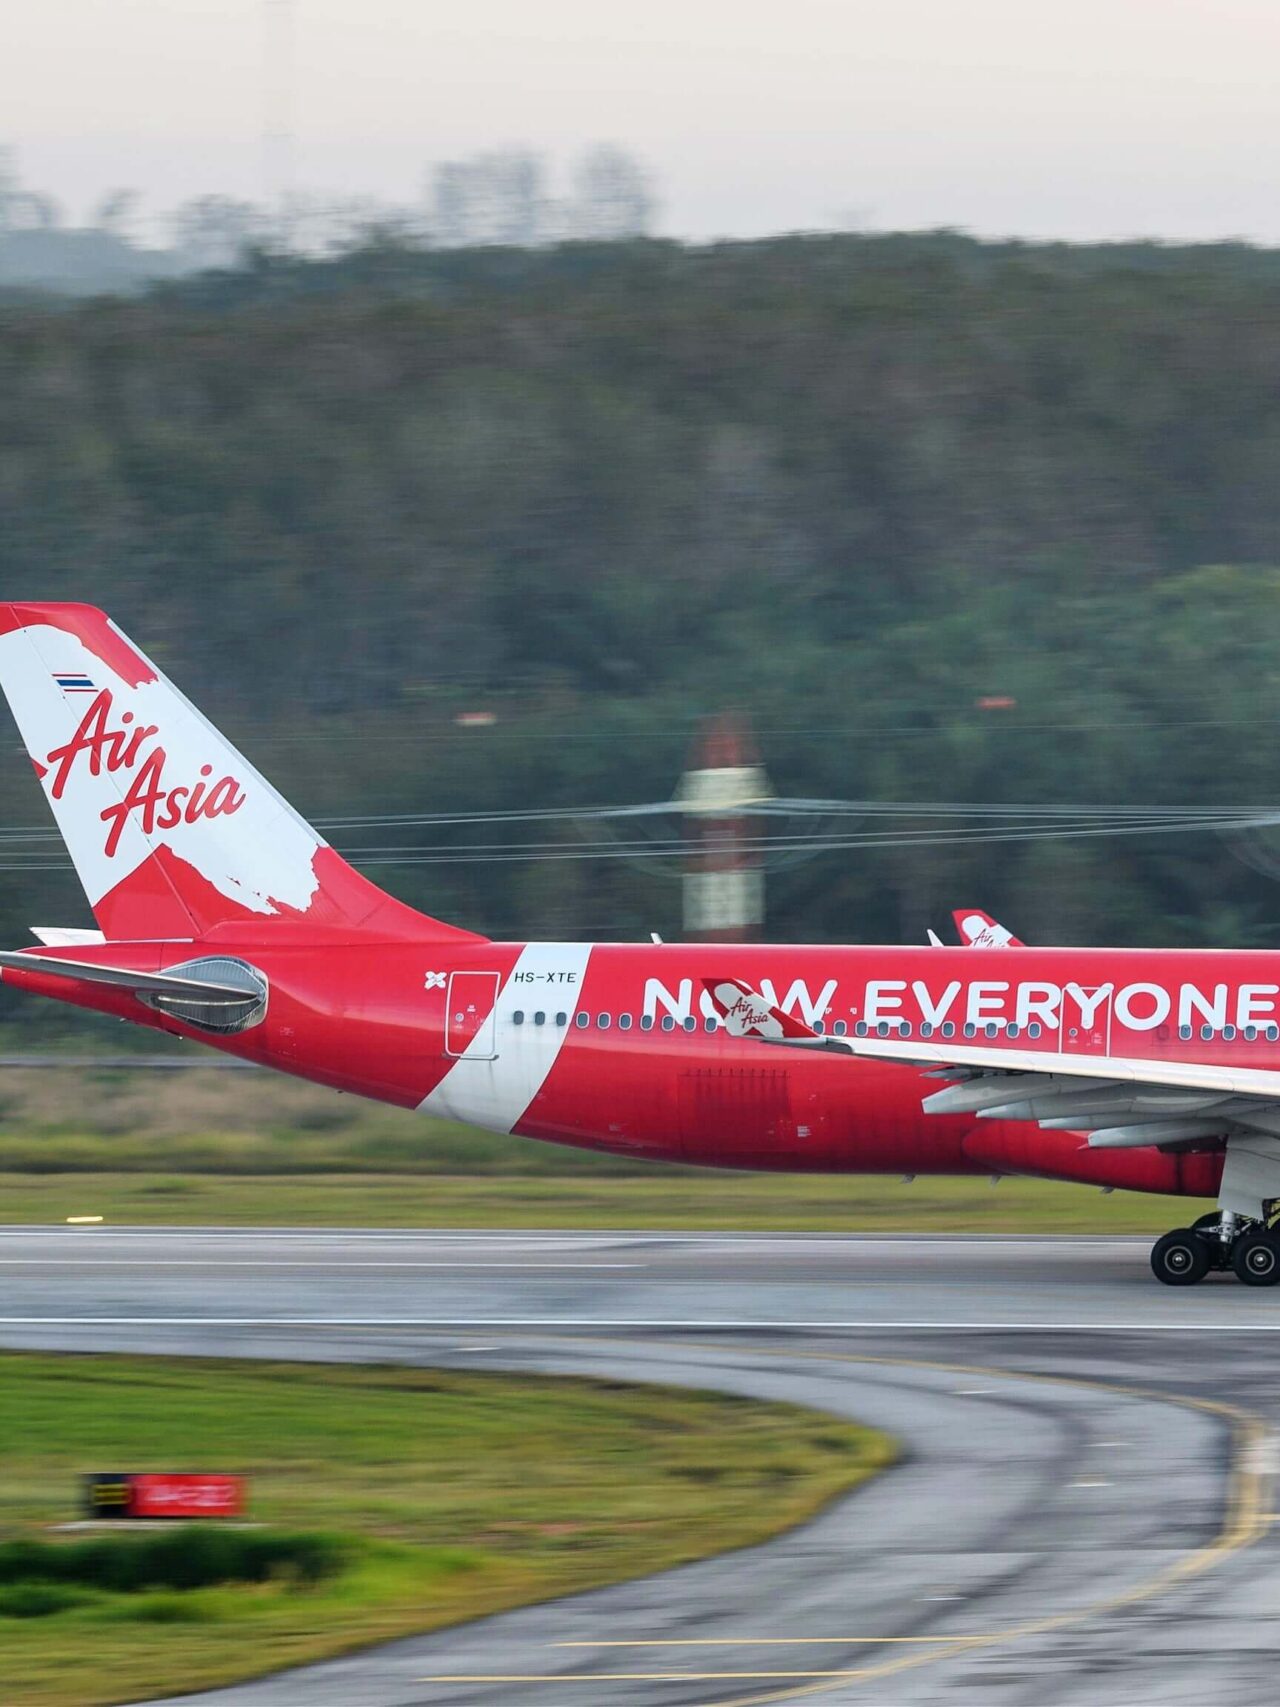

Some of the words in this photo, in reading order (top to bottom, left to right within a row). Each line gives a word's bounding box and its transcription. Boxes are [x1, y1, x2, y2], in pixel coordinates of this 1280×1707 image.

[47, 688, 159, 799] Air
[100, 747, 246, 858] Asia
[514, 972, 577, 983] HS-XTE
[730, 997, 752, 1017] Air
[741, 1008, 769, 1029] Asia
[863, 981, 1280, 1030] EVERYONE
